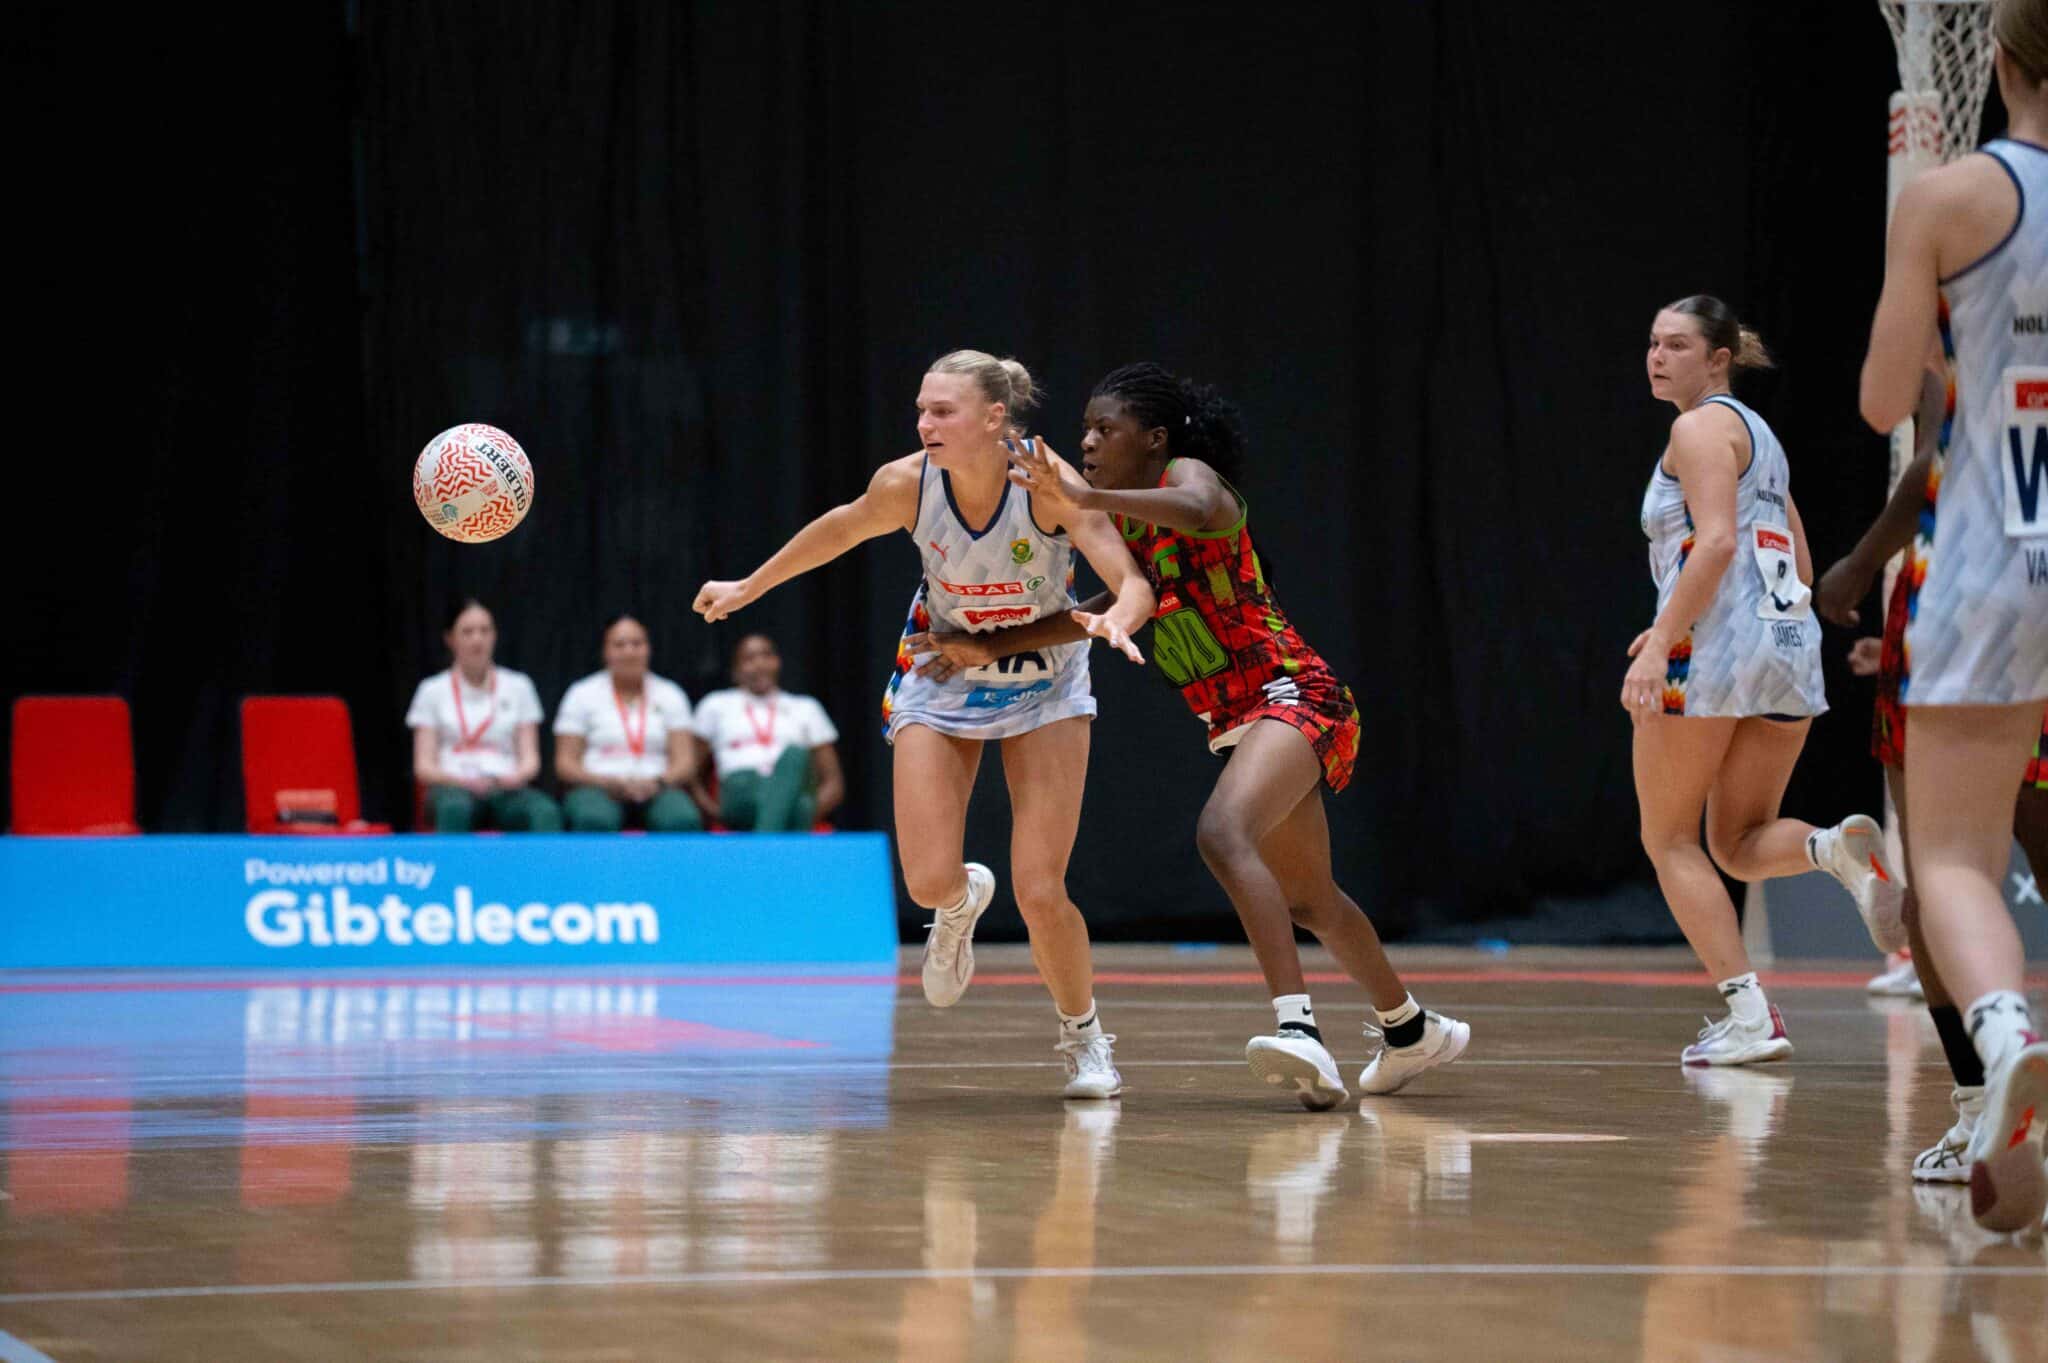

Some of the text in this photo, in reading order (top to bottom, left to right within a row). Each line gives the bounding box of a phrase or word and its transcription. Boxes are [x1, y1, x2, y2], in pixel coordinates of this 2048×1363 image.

[475, 443, 527, 511] GILBERT
[947, 582, 1022, 595] SPAR
[245, 858, 435, 889] Powered by
[245, 886, 659, 947] Gibtelecom
